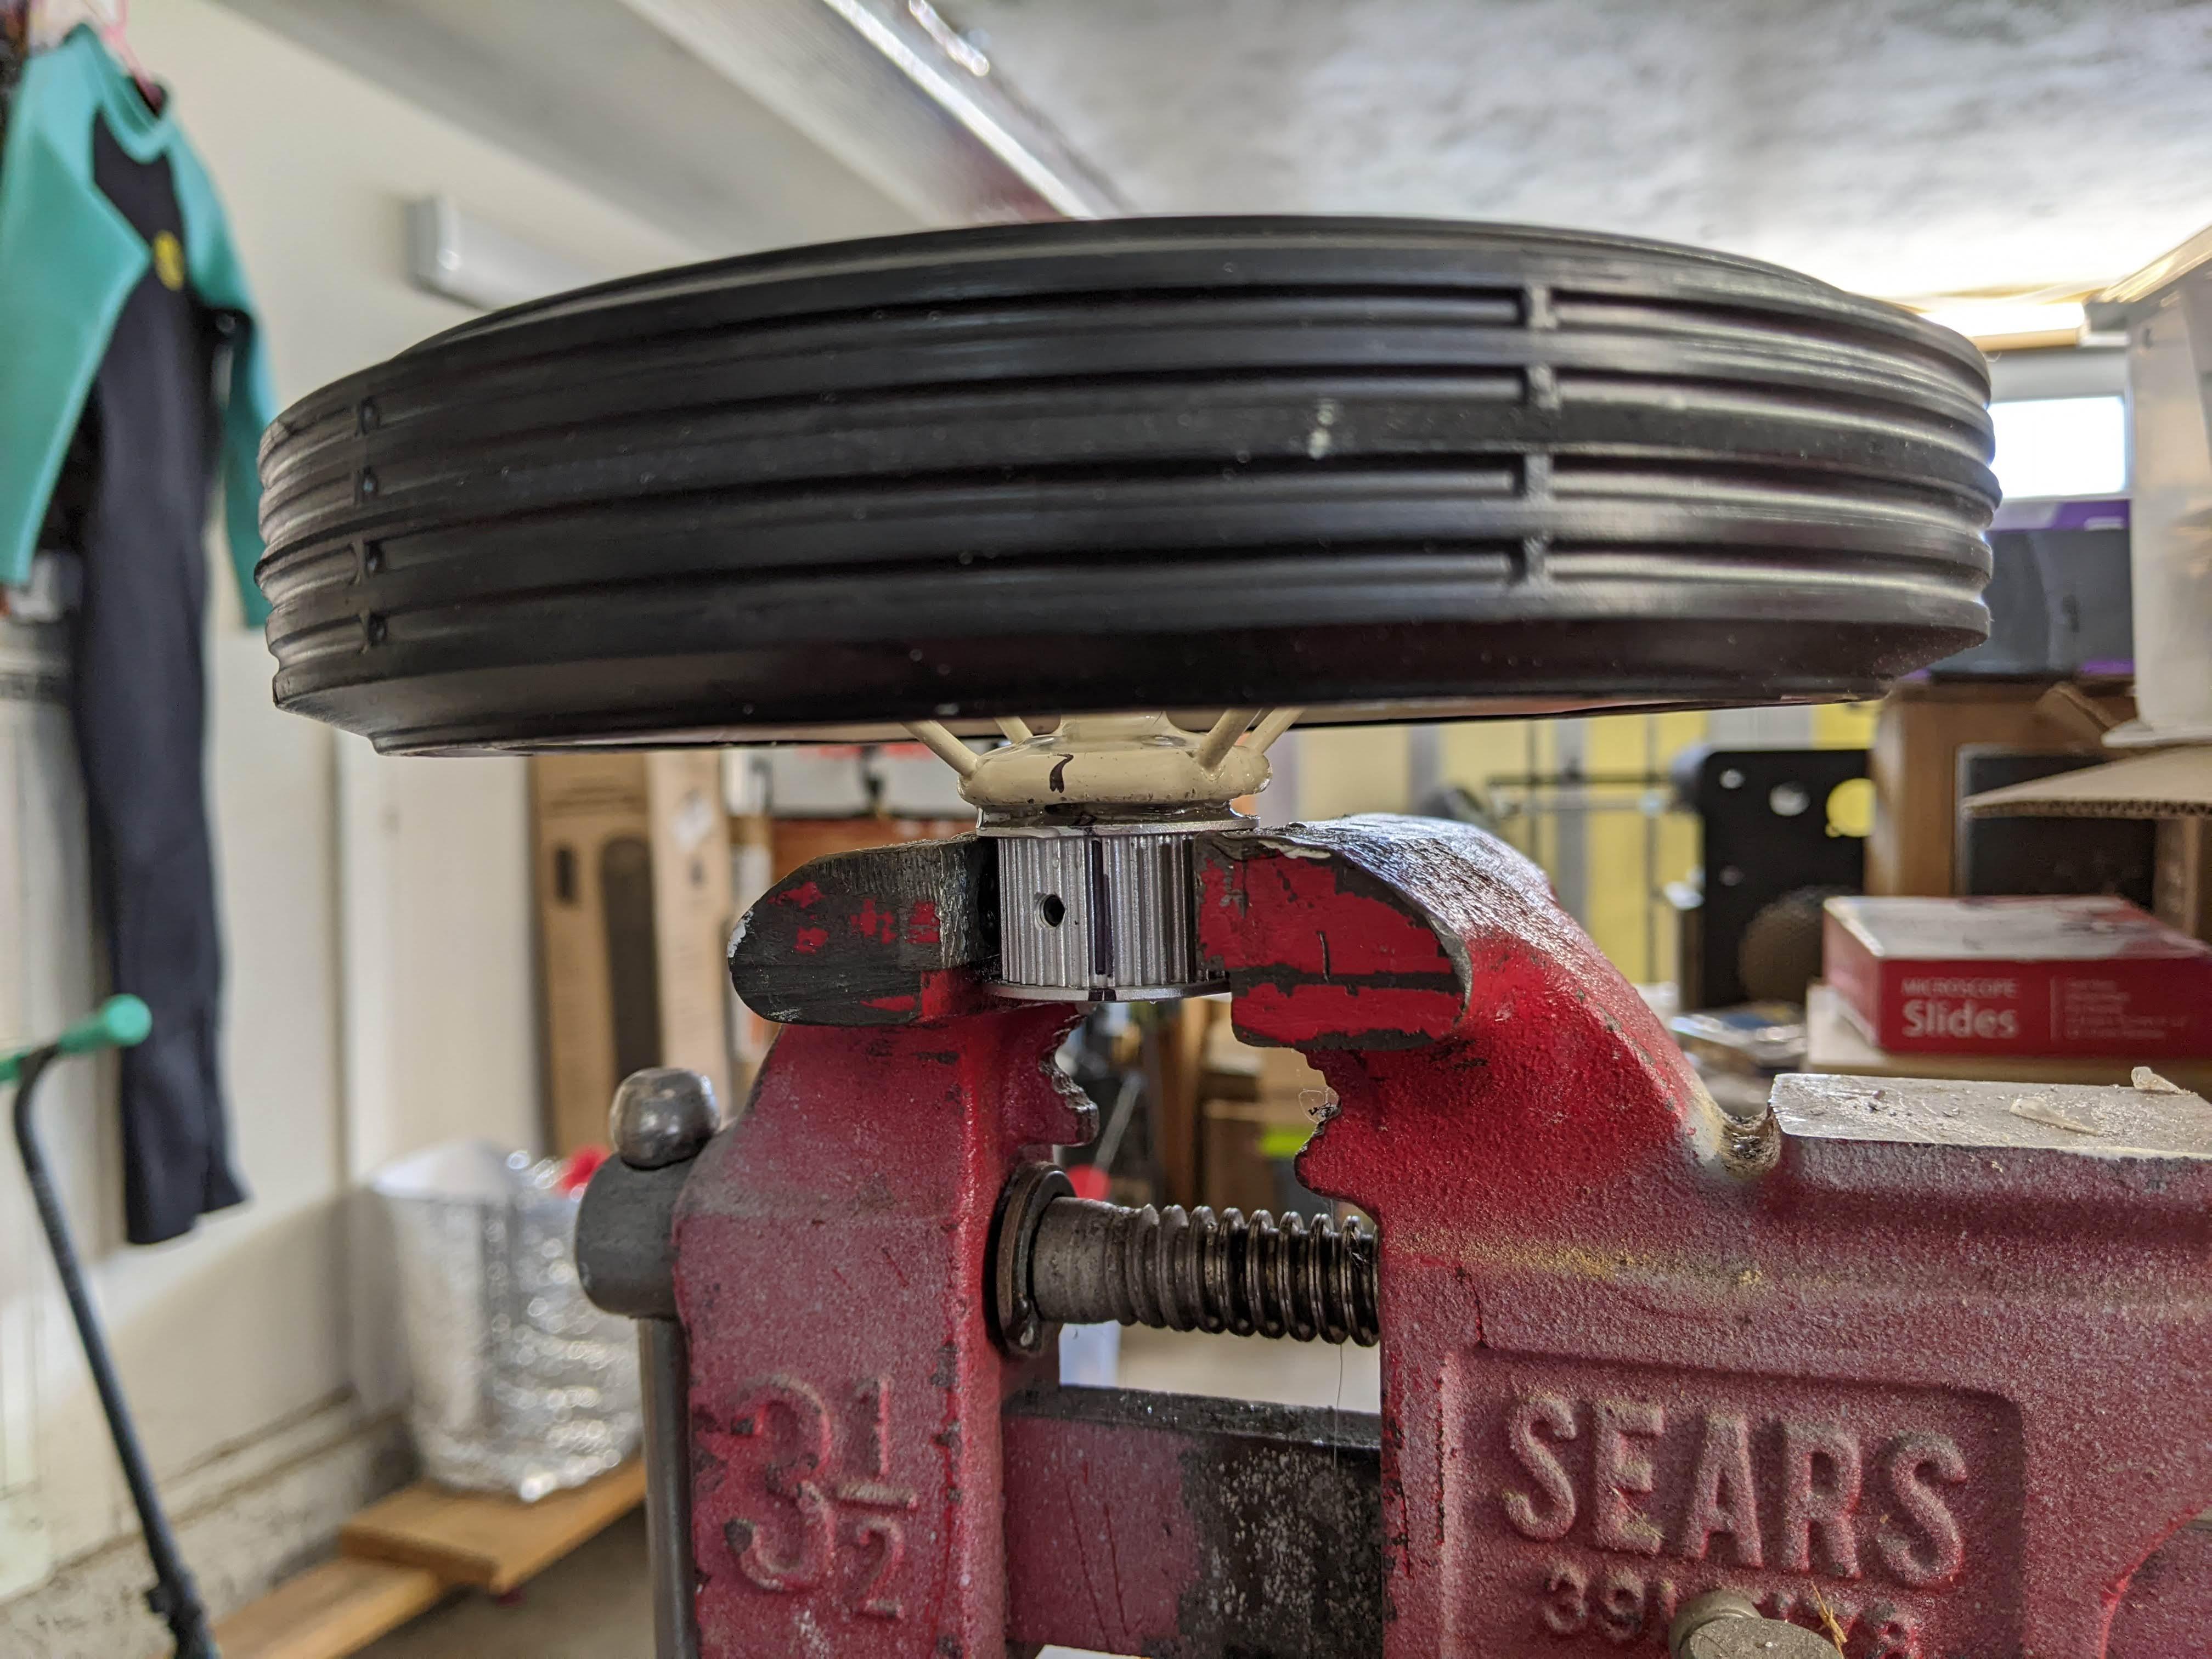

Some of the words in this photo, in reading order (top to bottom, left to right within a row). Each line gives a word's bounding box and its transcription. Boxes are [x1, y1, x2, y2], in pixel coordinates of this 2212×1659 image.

[1901, 977, 2019, 998] MICROSCOPE
[1901, 999, 2020, 1038] Slides
[720, 1373, 836, 1591] 3
[1502, 1392, 1966, 1590] SEARS
